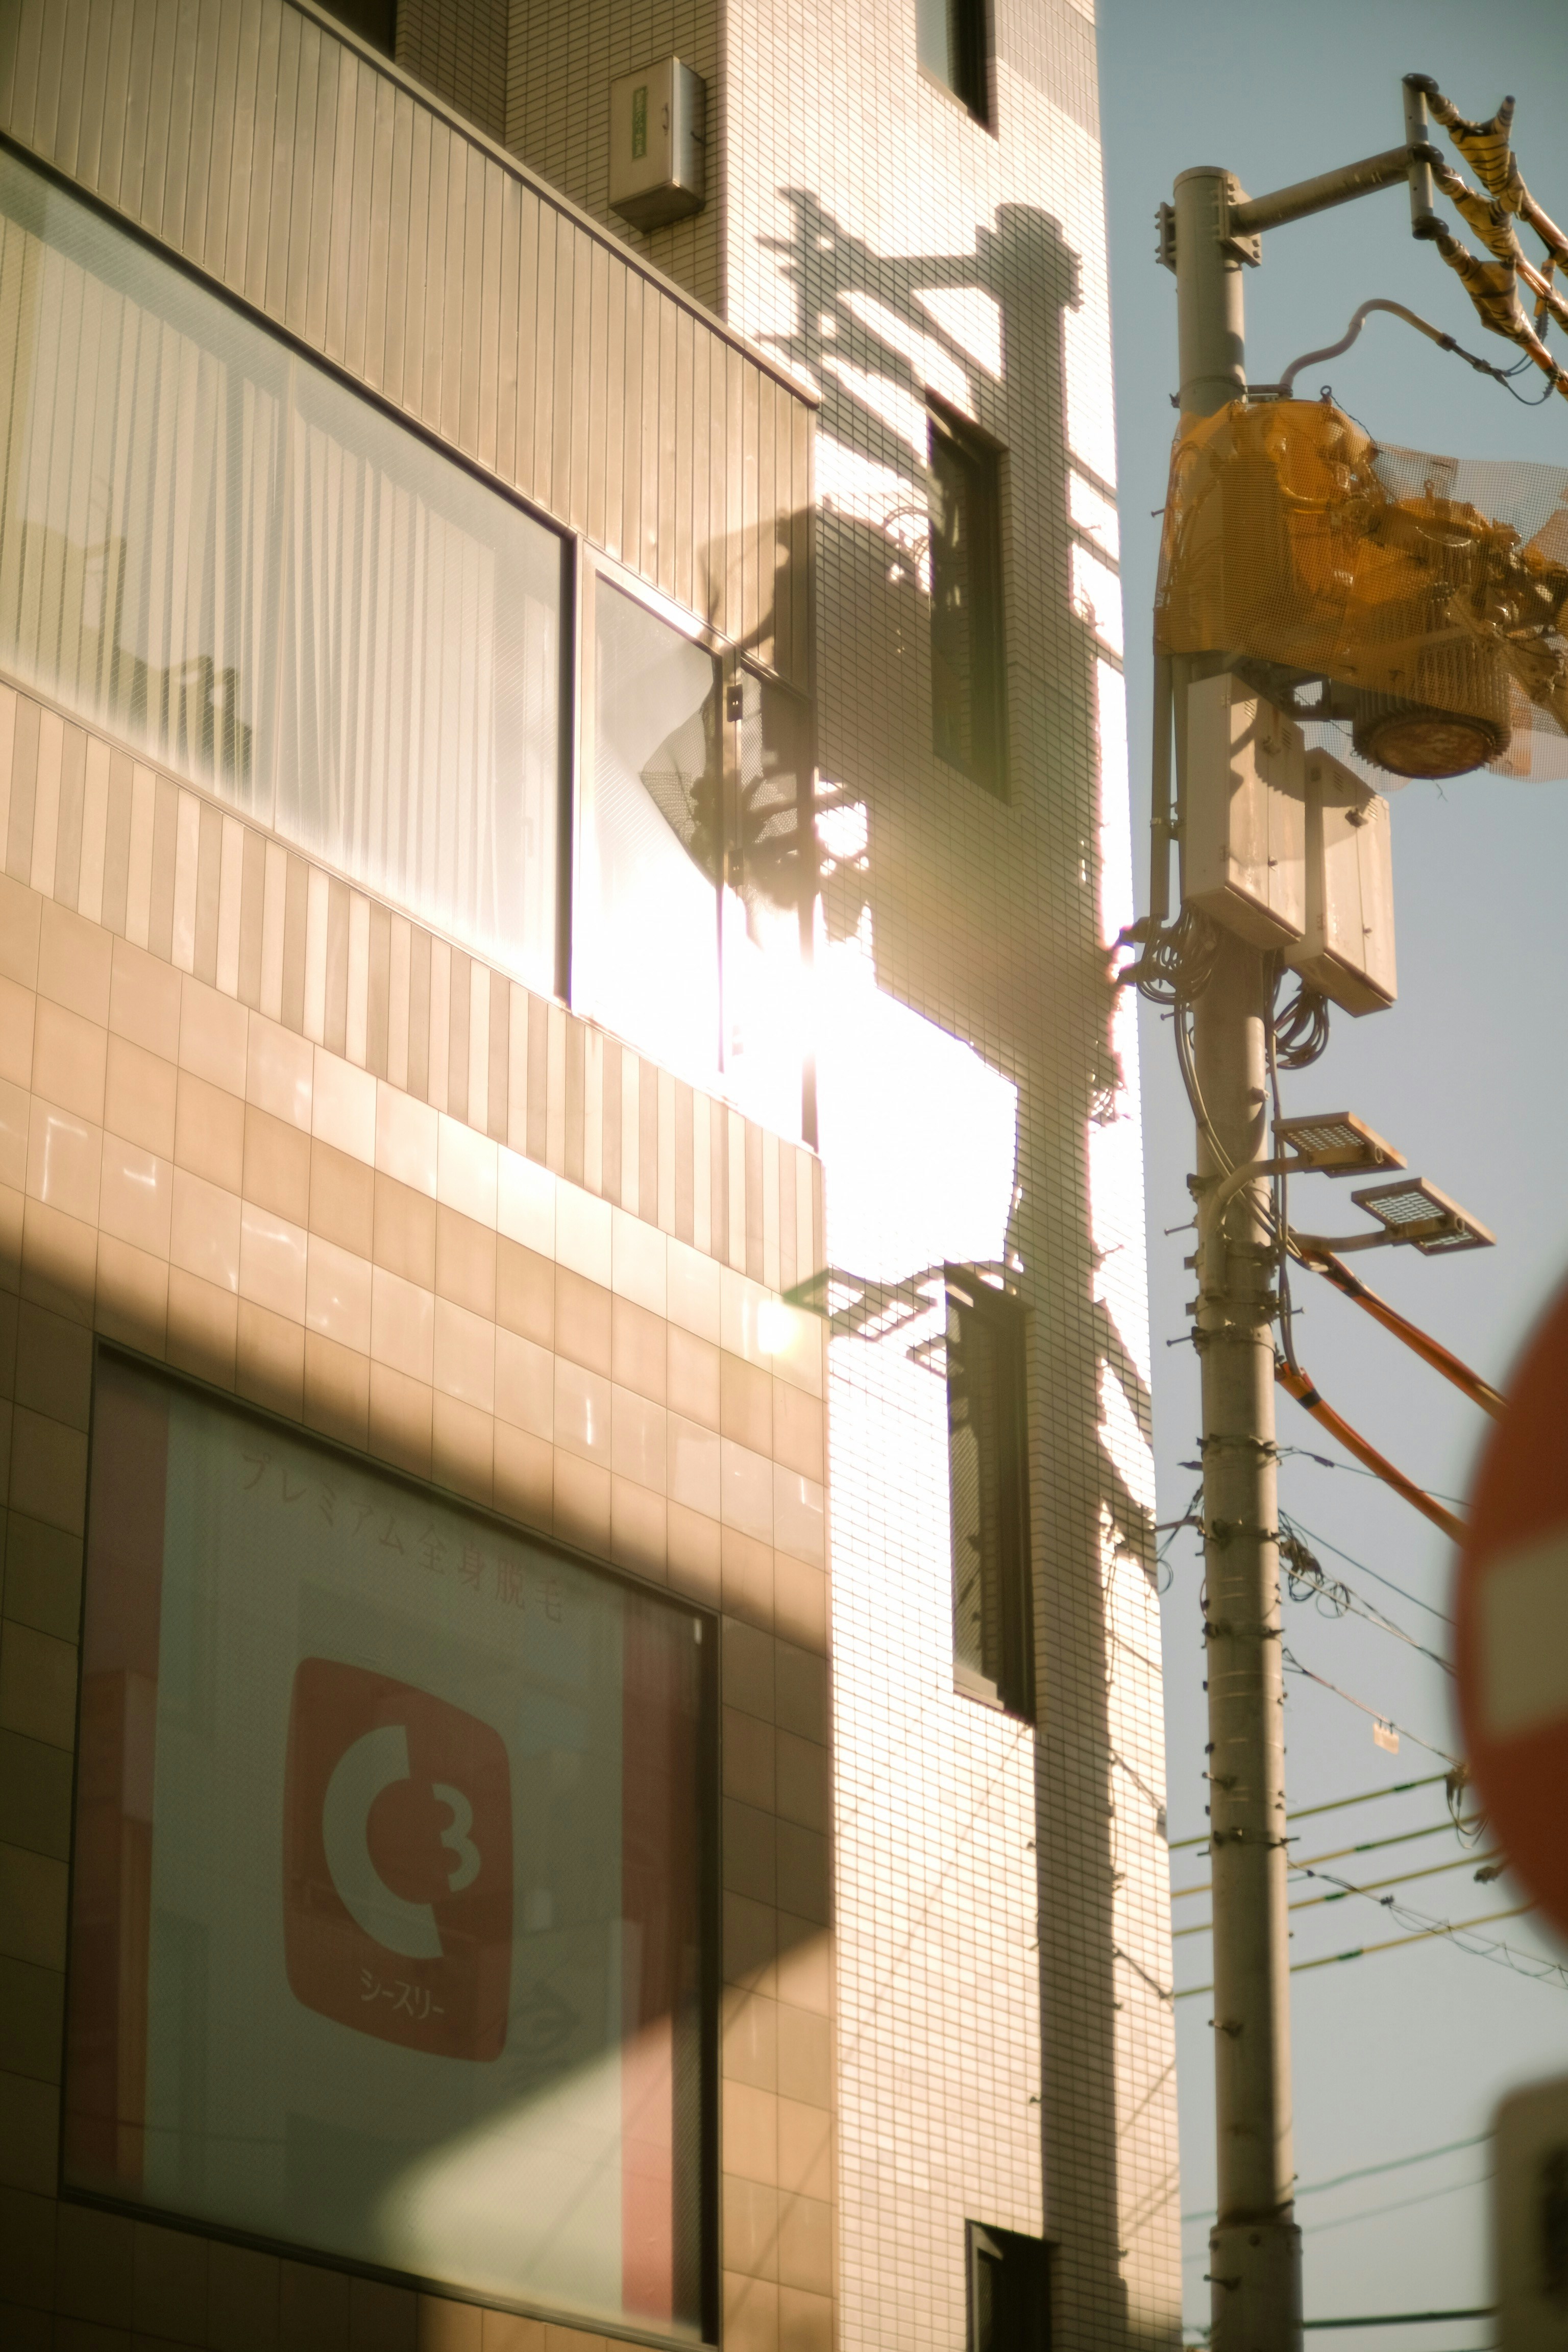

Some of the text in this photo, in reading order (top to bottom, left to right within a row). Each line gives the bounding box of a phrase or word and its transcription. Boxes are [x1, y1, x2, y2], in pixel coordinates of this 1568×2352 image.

[242, 1451, 563, 1624] プレミアム全身脱毛
[360, 1968, 445, 2020] シースリー
